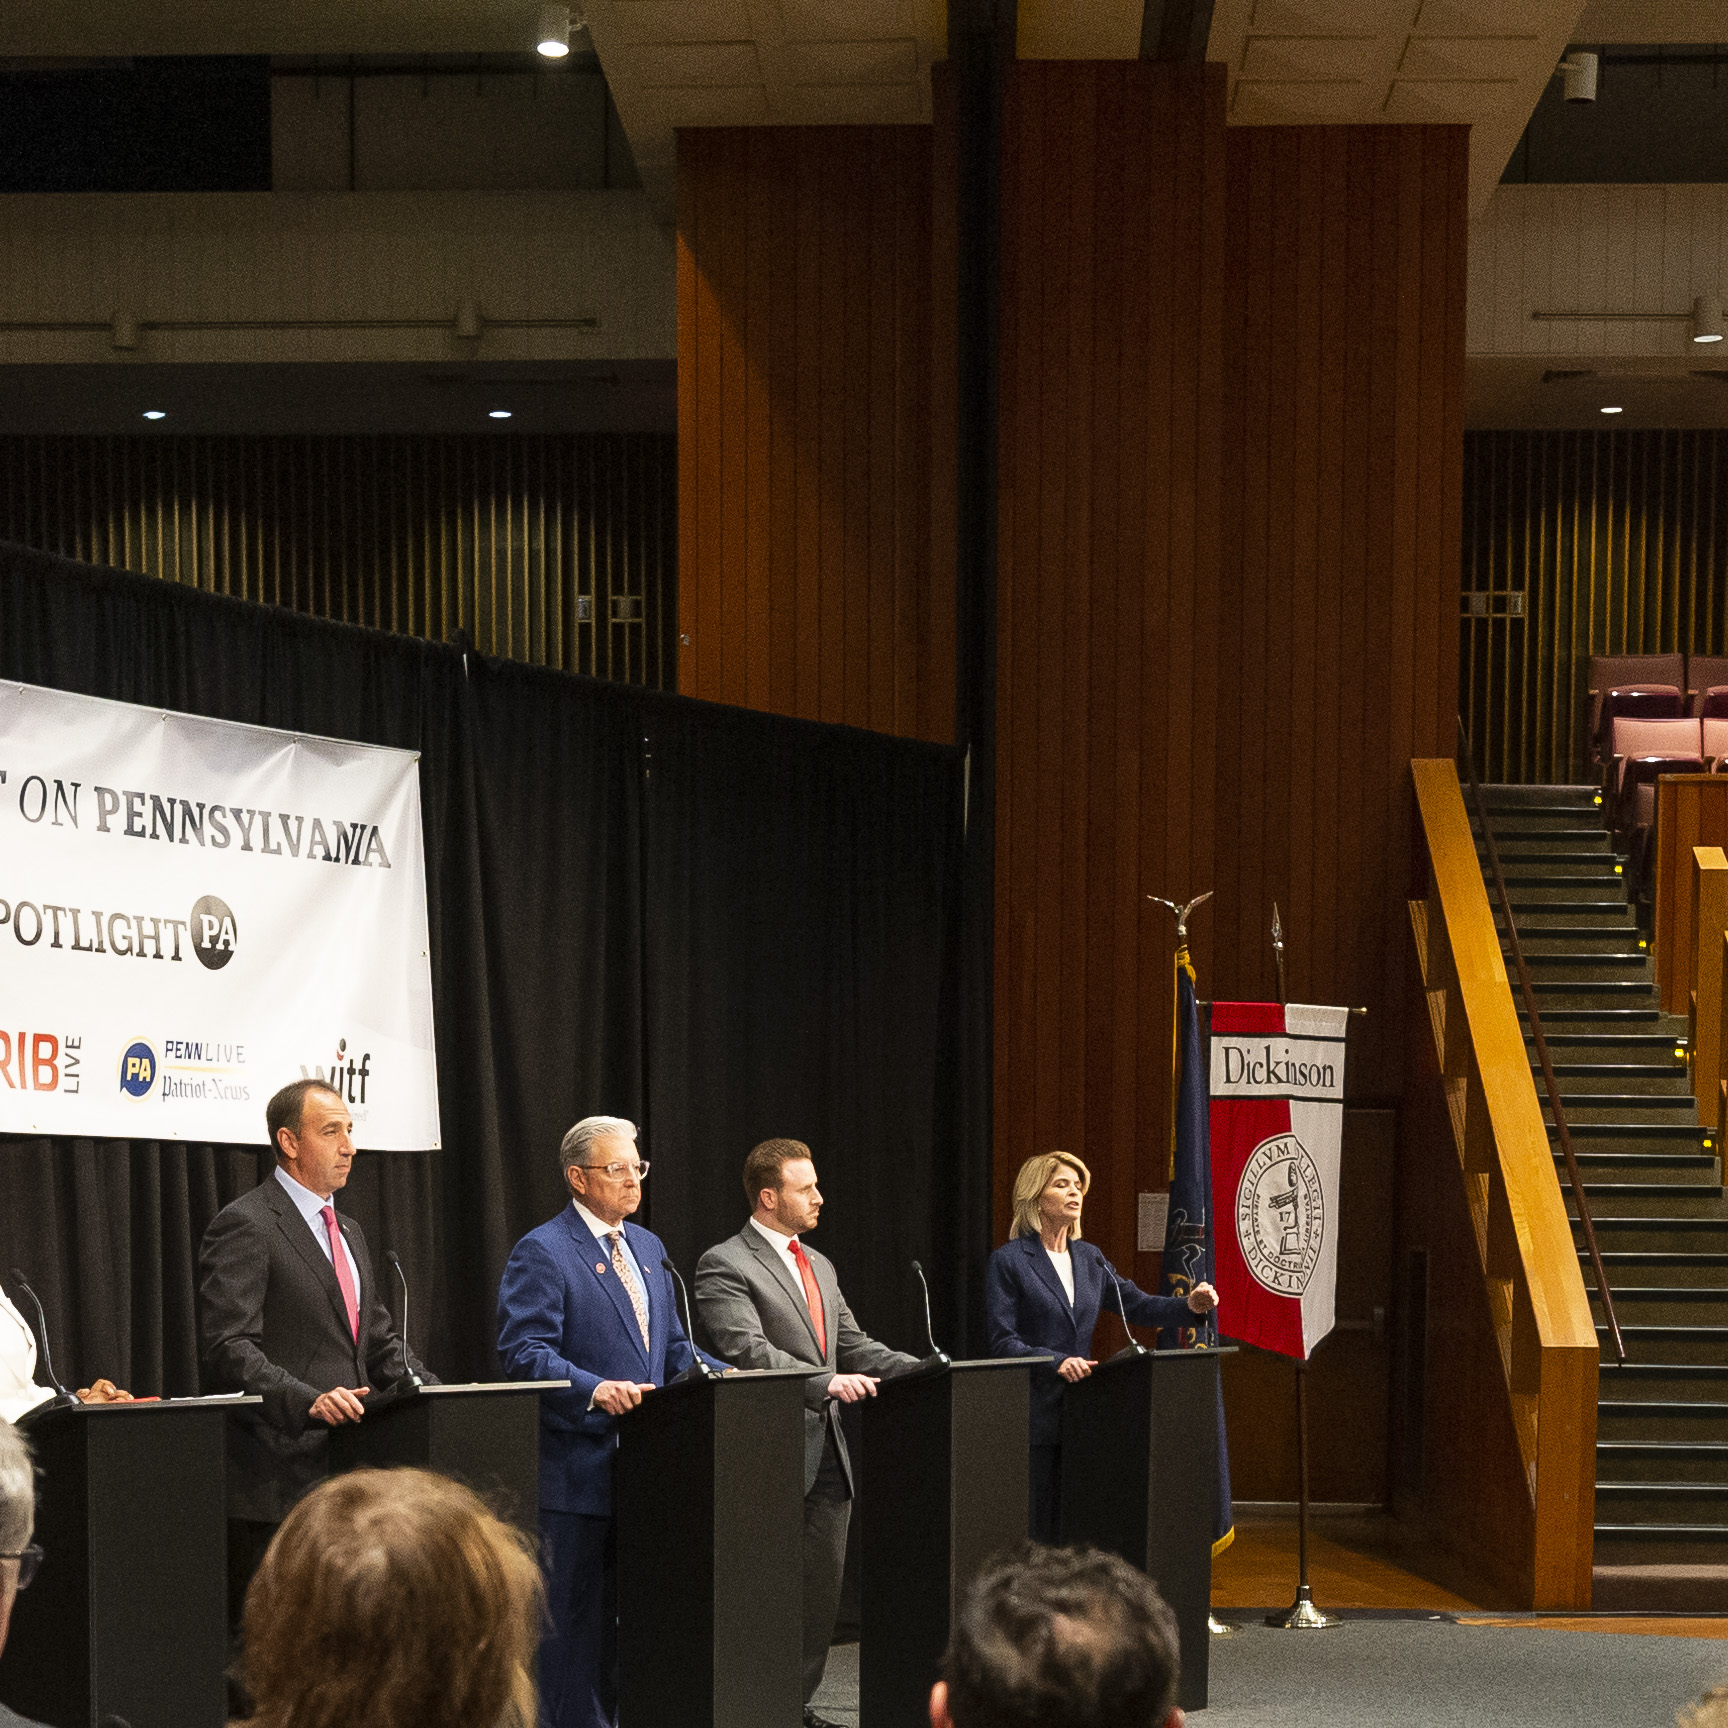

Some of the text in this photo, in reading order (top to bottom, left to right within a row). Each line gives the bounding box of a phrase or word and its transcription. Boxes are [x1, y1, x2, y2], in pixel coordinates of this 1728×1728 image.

[19, 775, 82, 829] ON
[93, 786, 391, 869] PENNSYLVANIA
[199, 912, 237, 952] PA
[64, 1035, 82, 1094] LIVE
[125, 1056, 152, 1082] PA
[1221, 1044, 1336, 1088] Dickinson
[162, 1075, 250, 1102] Patriot-News
